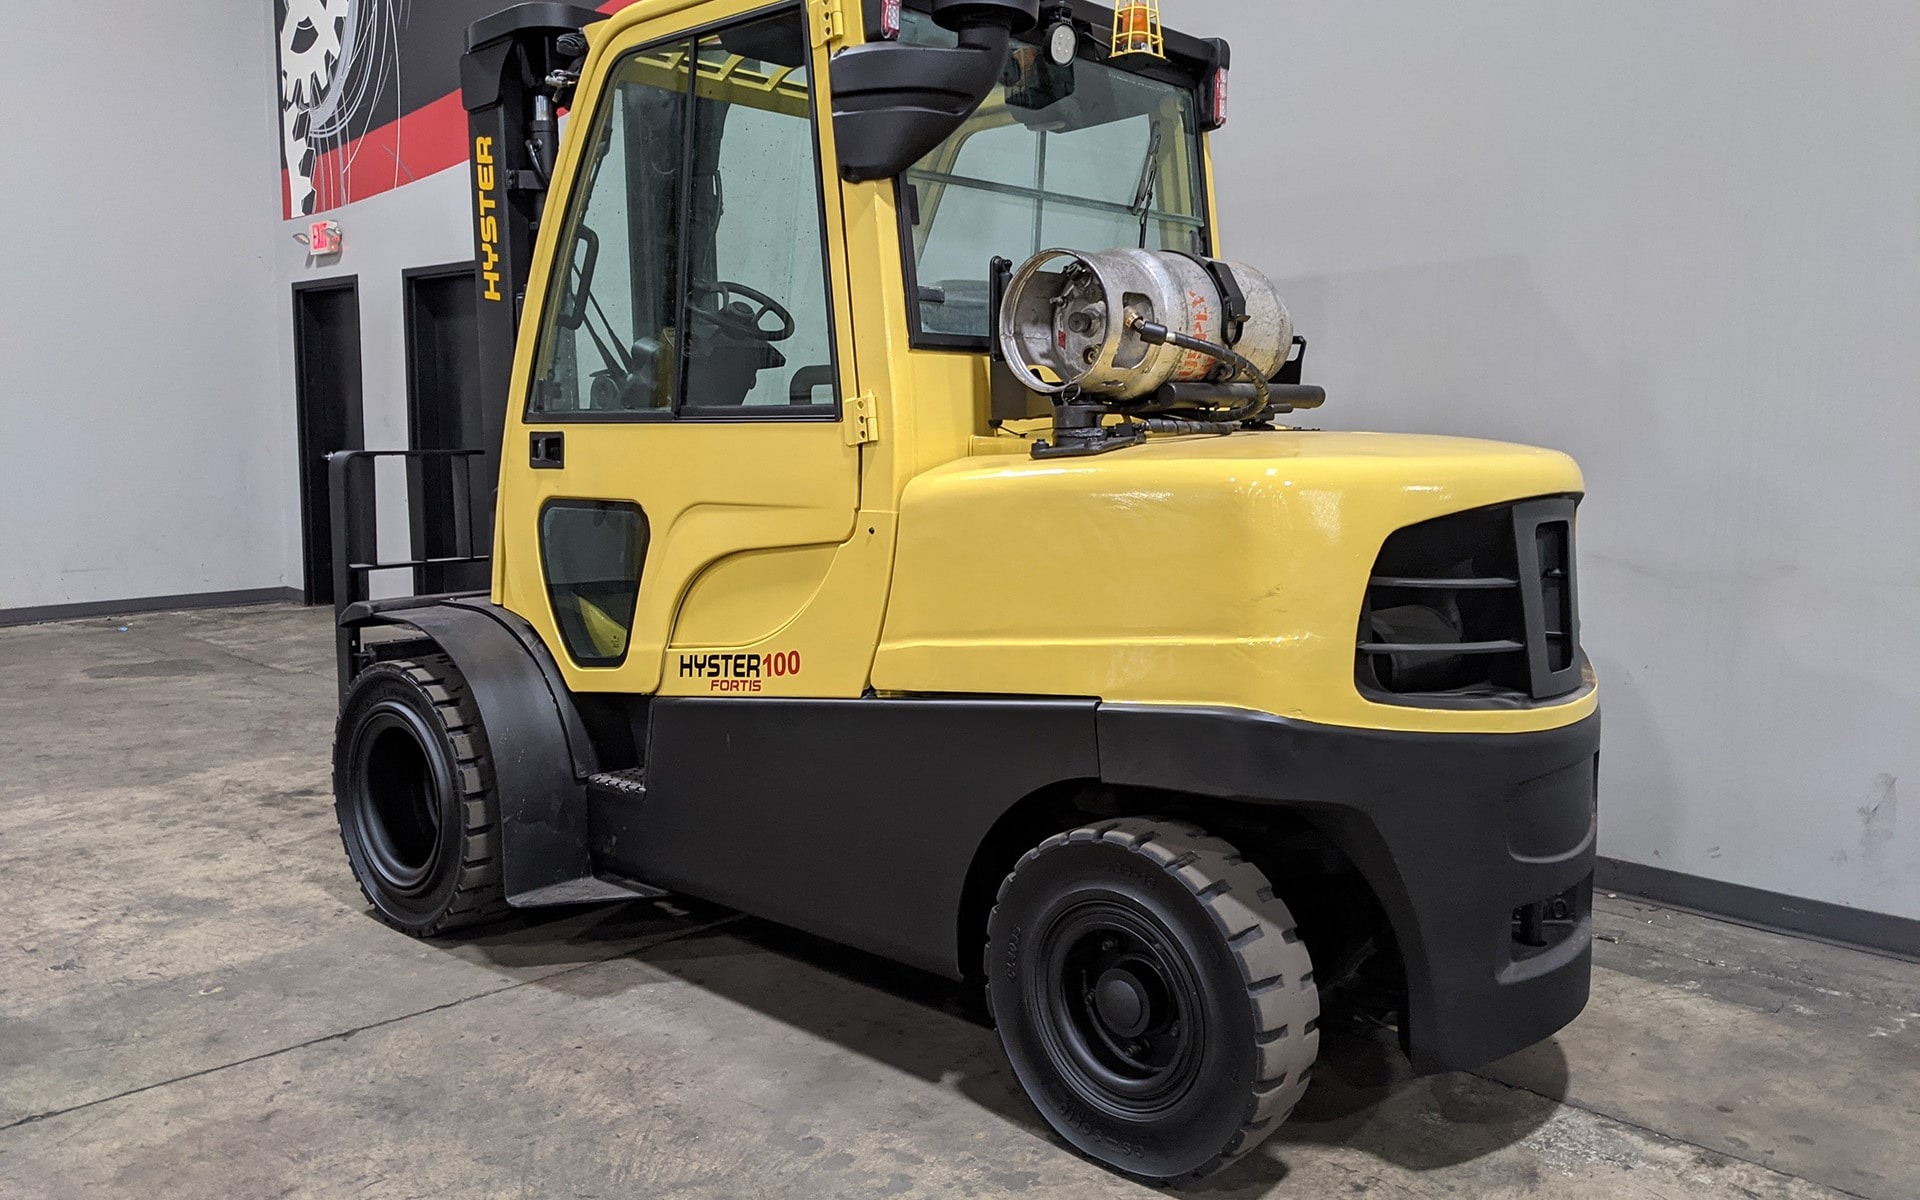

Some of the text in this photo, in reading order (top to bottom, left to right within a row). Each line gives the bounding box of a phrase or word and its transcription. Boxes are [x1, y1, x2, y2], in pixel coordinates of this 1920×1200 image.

[475, 136, 502, 301] HYSTER
[680, 650, 800, 677] HYSTER 100
[710, 680, 761, 691] FORTIS
